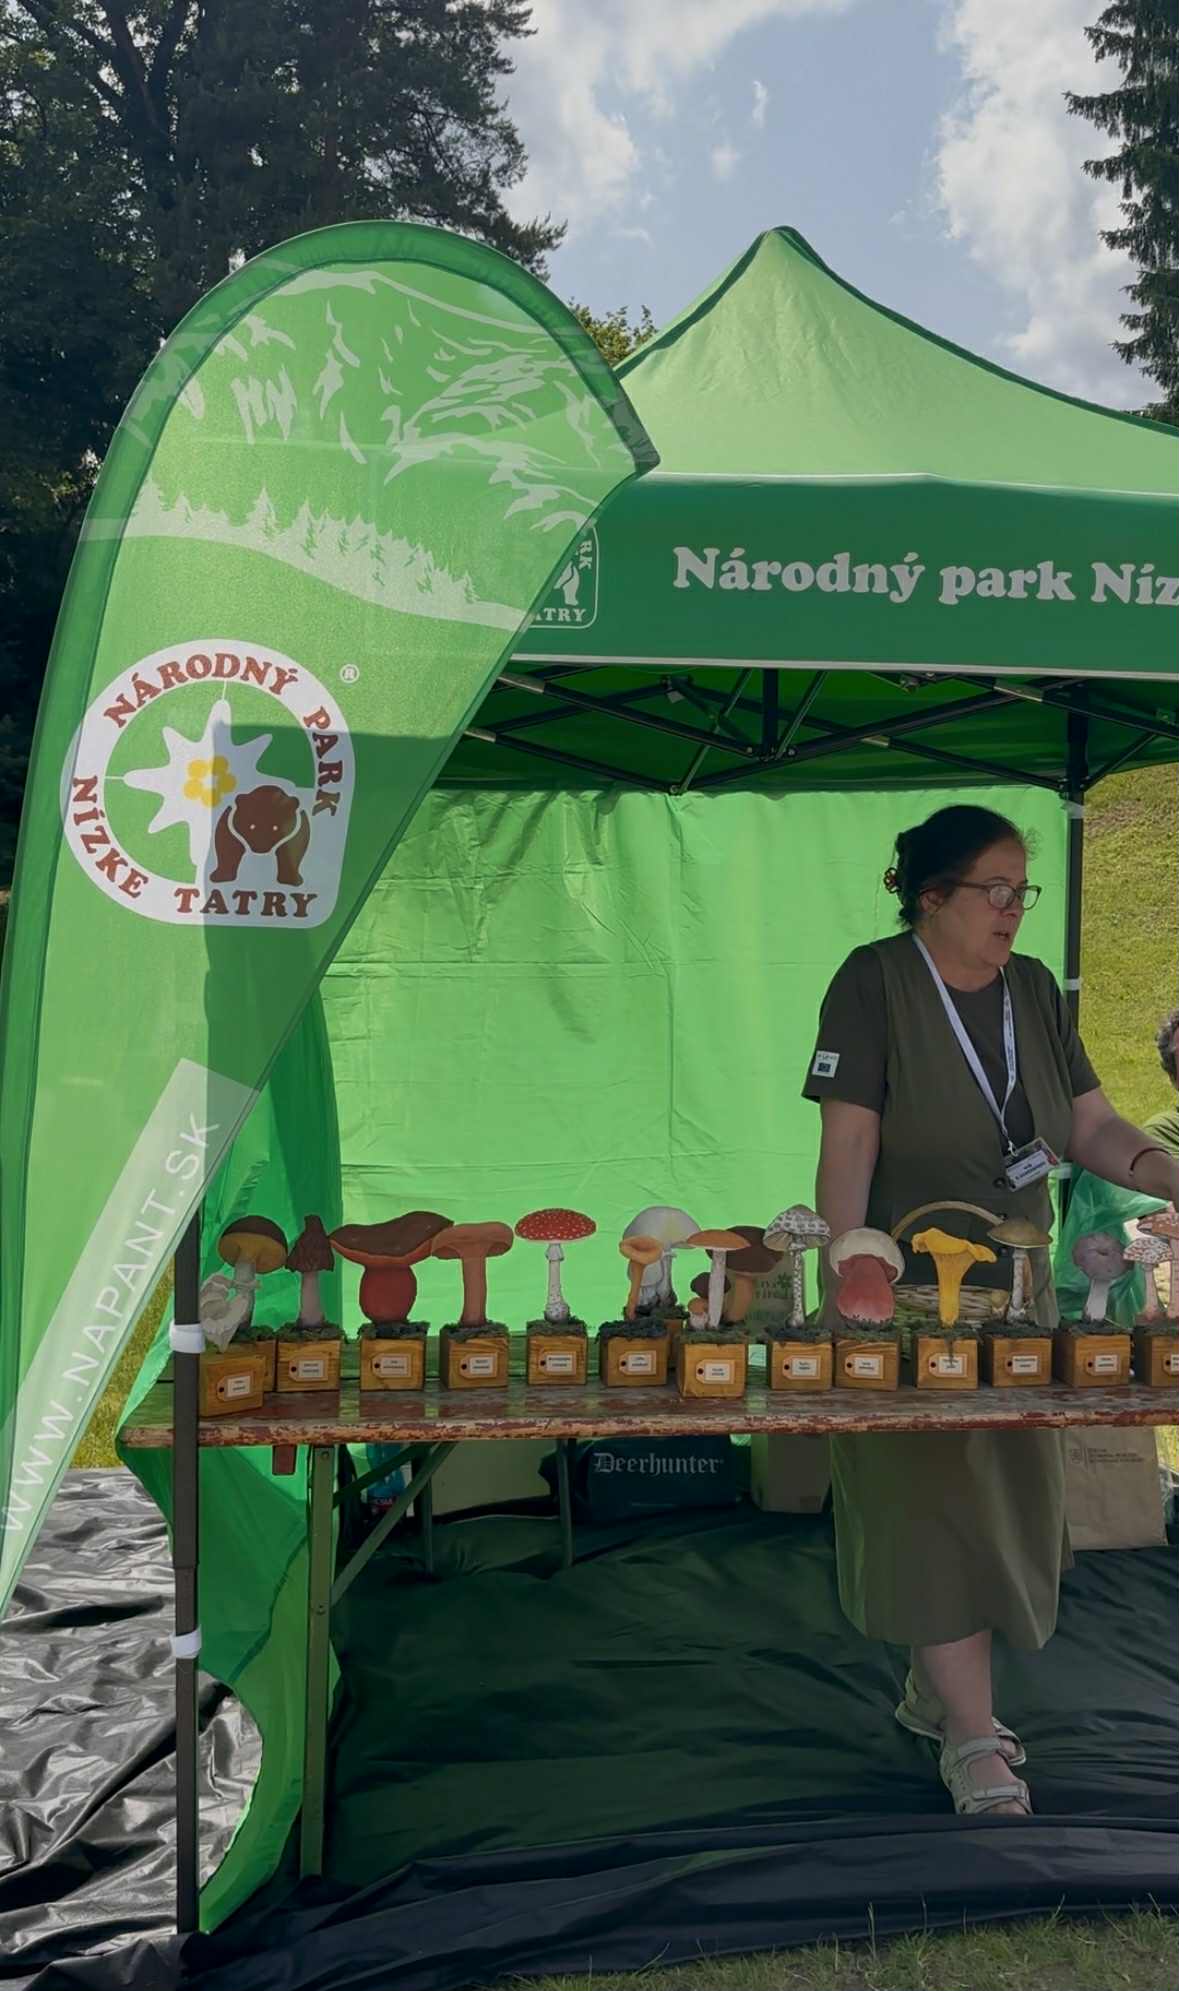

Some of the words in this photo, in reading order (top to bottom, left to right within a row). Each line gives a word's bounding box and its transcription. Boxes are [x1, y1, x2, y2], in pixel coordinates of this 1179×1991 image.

[673, 547, 925, 602] Národný
[939, 561, 1077, 606] park
[1091, 562, 1179, 606] Níz
[104, 653, 298, 728] NÁRODNÝ
[304, 706, 344, 816] PARK
[72, 775, 149, 898] NÍZKE
[174, 888, 318, 917] TATRY
[0, 1113, 219, 1531] WWW.NAPANT.SK
[593, 1452, 720, 1476] Deerhunter
